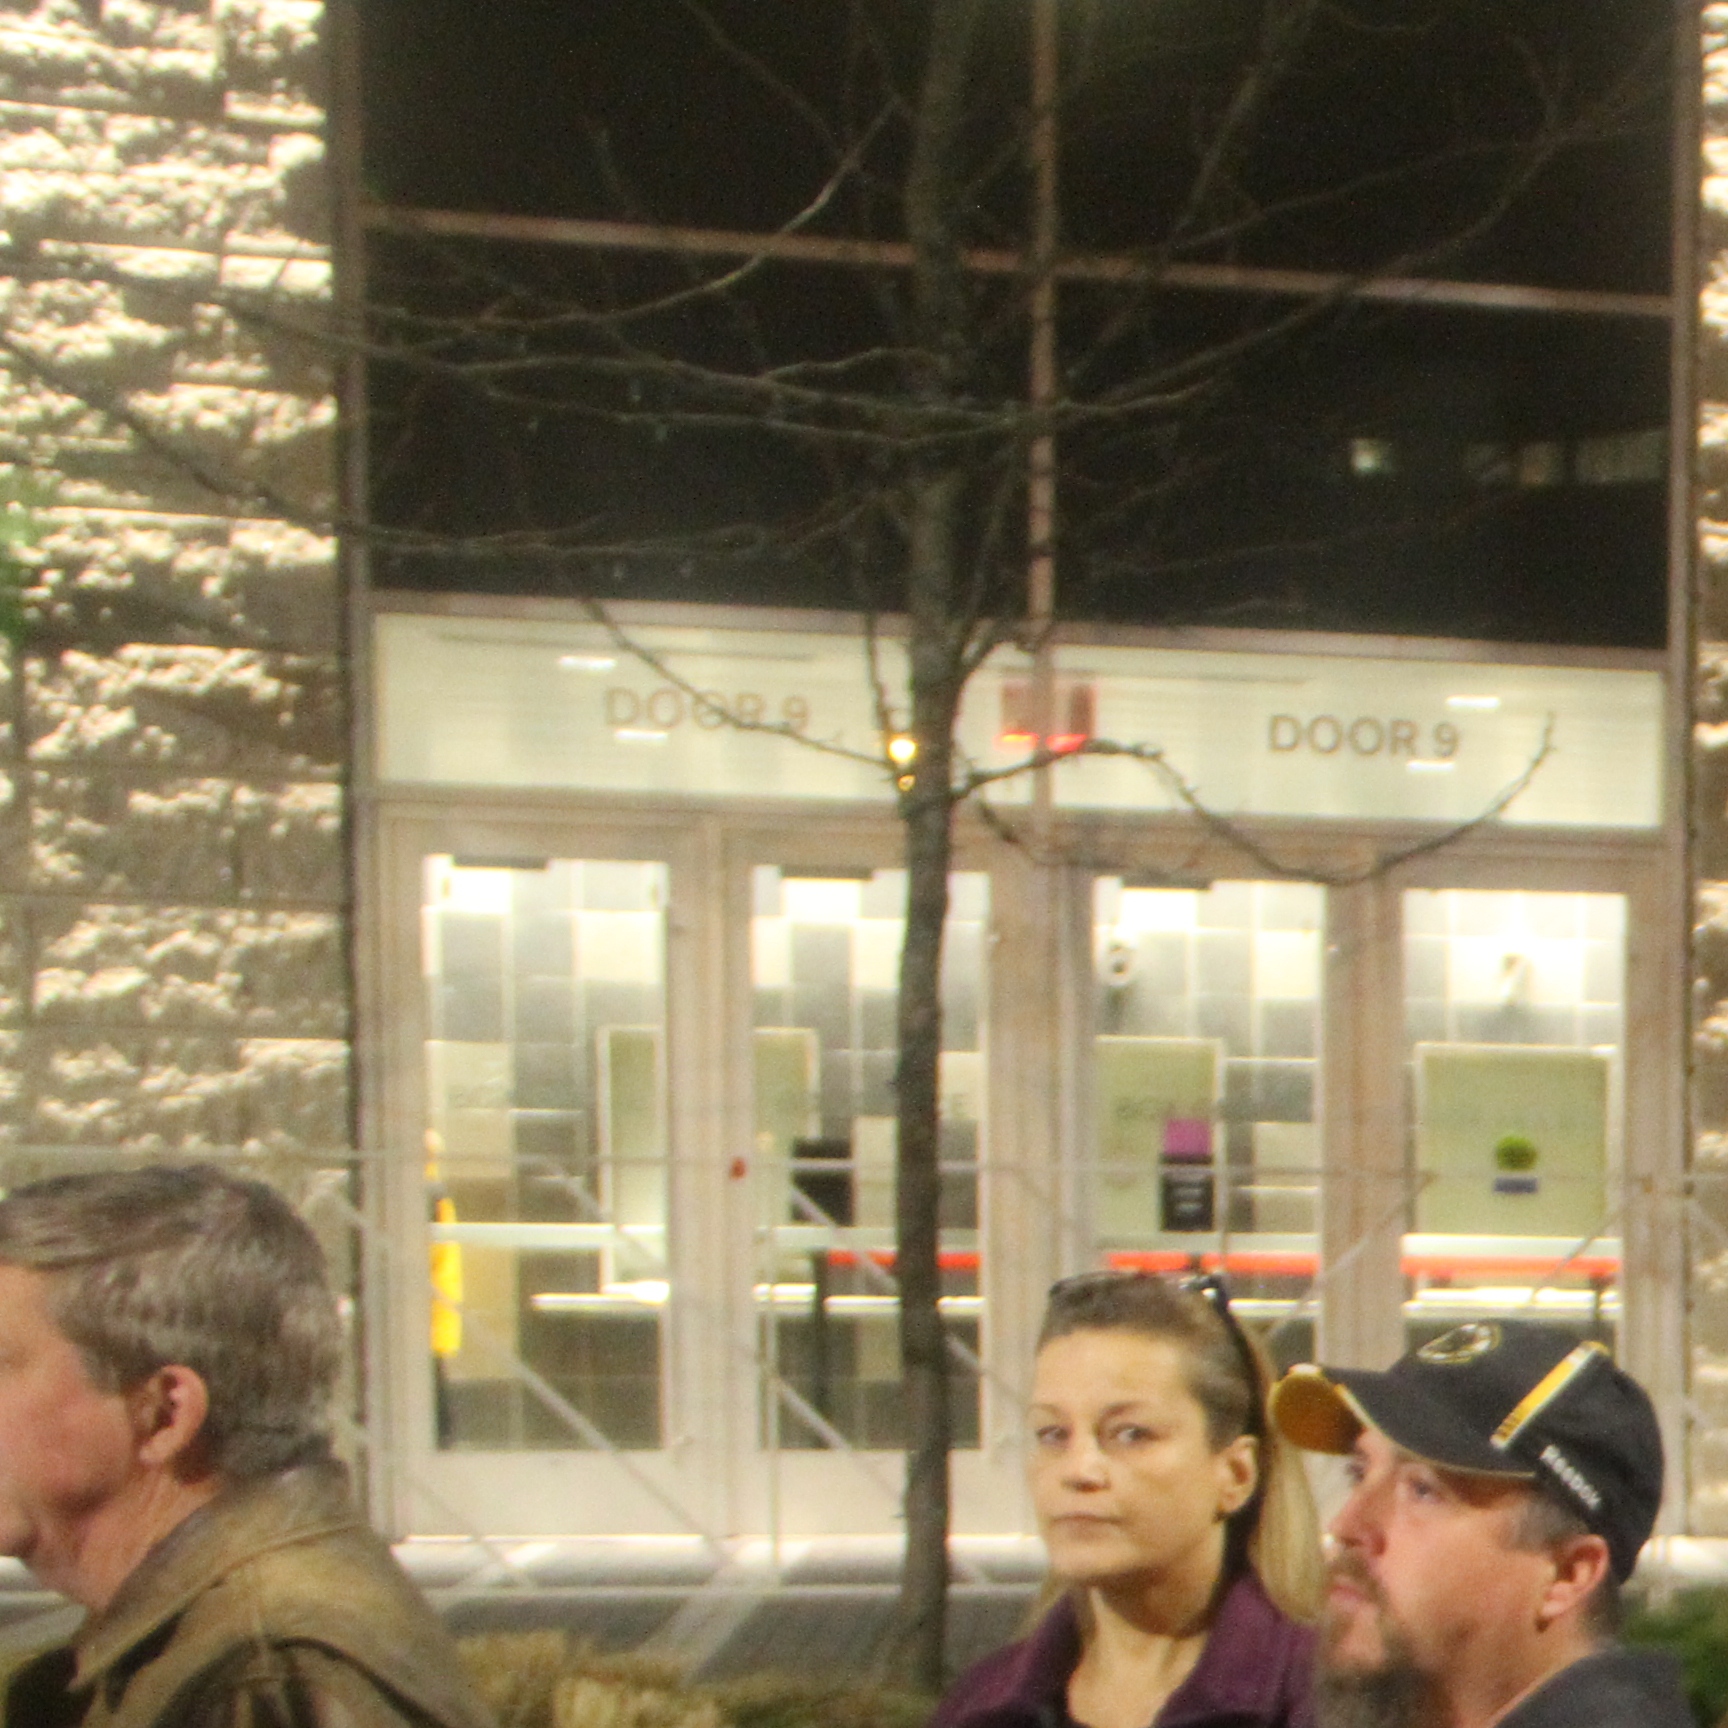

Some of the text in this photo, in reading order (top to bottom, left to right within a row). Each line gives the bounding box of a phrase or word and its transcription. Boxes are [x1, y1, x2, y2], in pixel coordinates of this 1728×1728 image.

[605, 687, 765, 731] DOOR
[1269, 714, 1460, 759] DOOR 9
